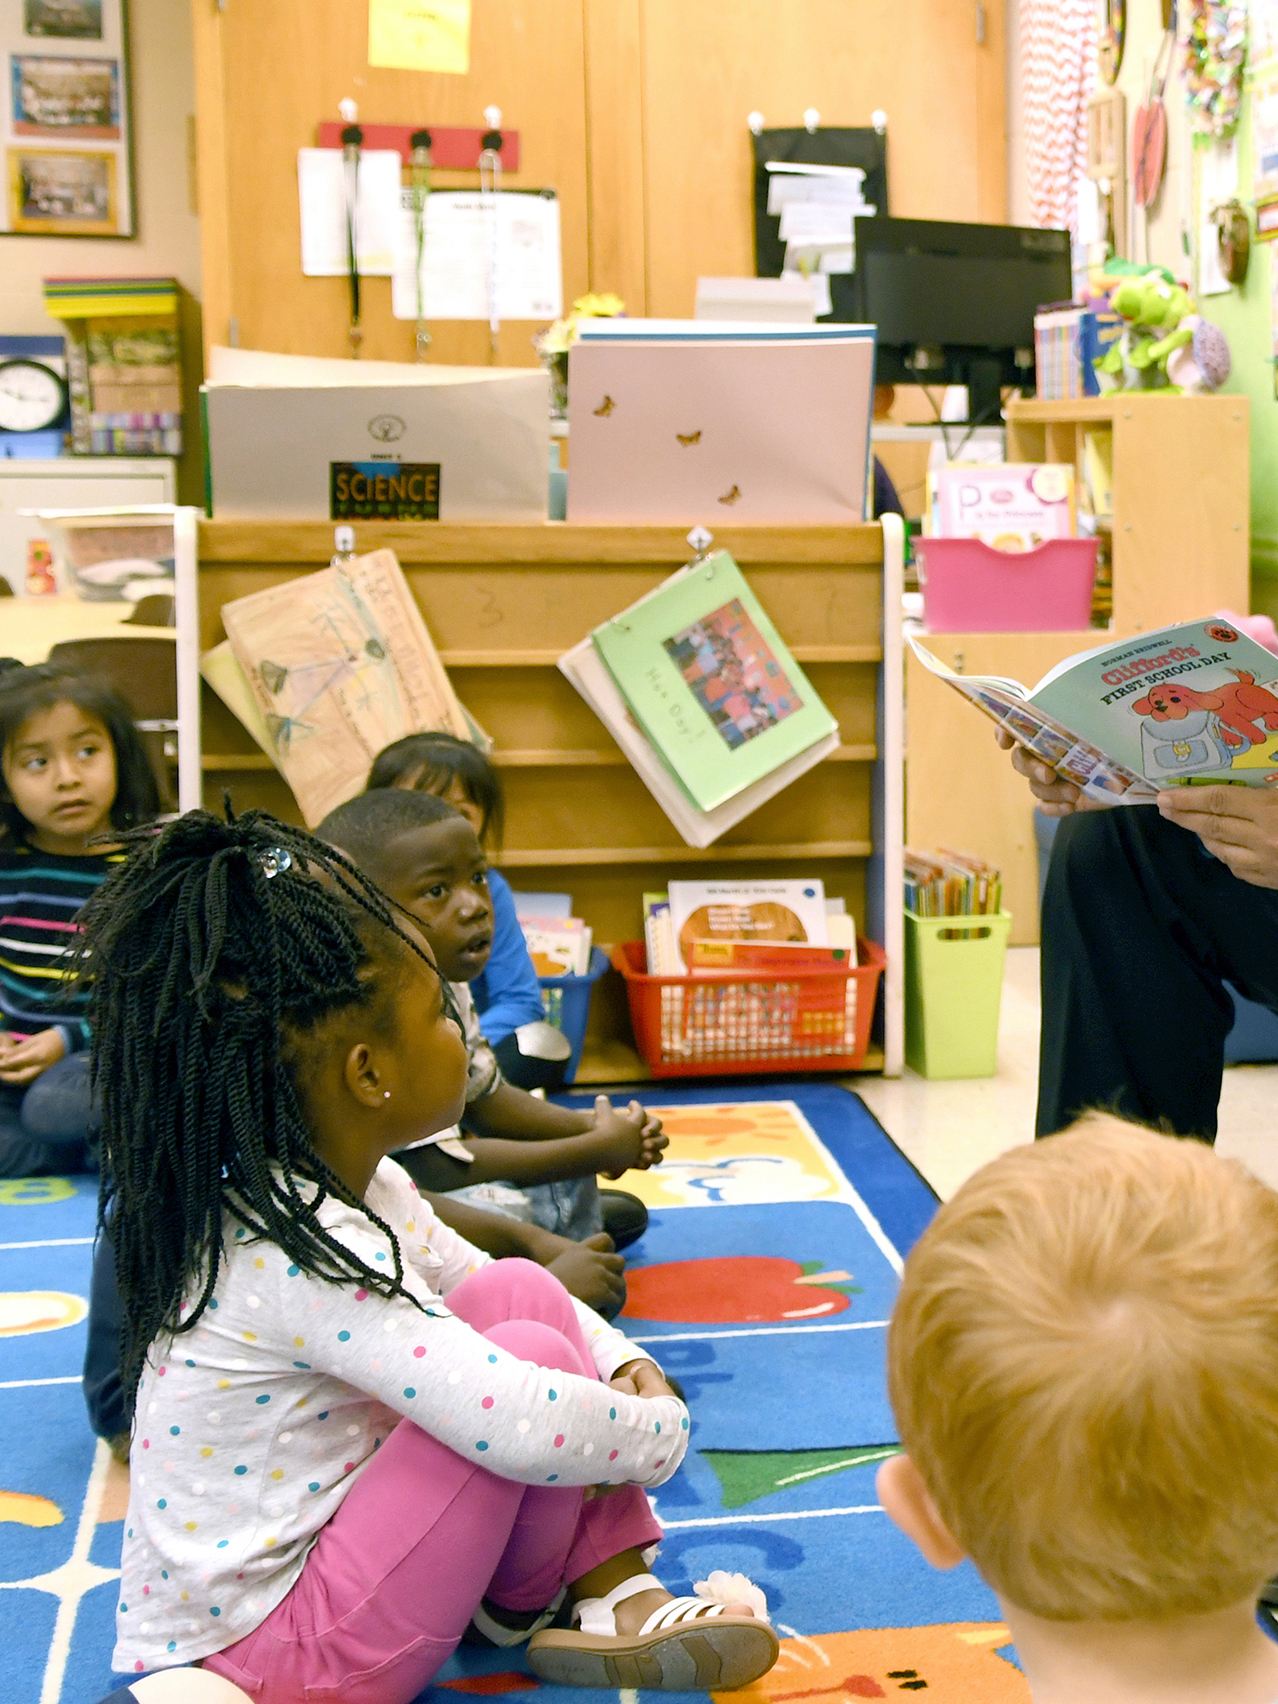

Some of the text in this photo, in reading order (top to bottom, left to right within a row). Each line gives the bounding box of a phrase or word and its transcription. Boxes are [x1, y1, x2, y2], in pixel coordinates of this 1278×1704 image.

[336, 472, 438, 502] SCIENCE
[960, 484, 982, 520] P
[1101, 638, 1173, 668] NORMAN BRIDWELL
[1101, 645, 1201, 686] Clifford's
[1100, 651, 1232, 706] FIRST SCHOOL DAY
